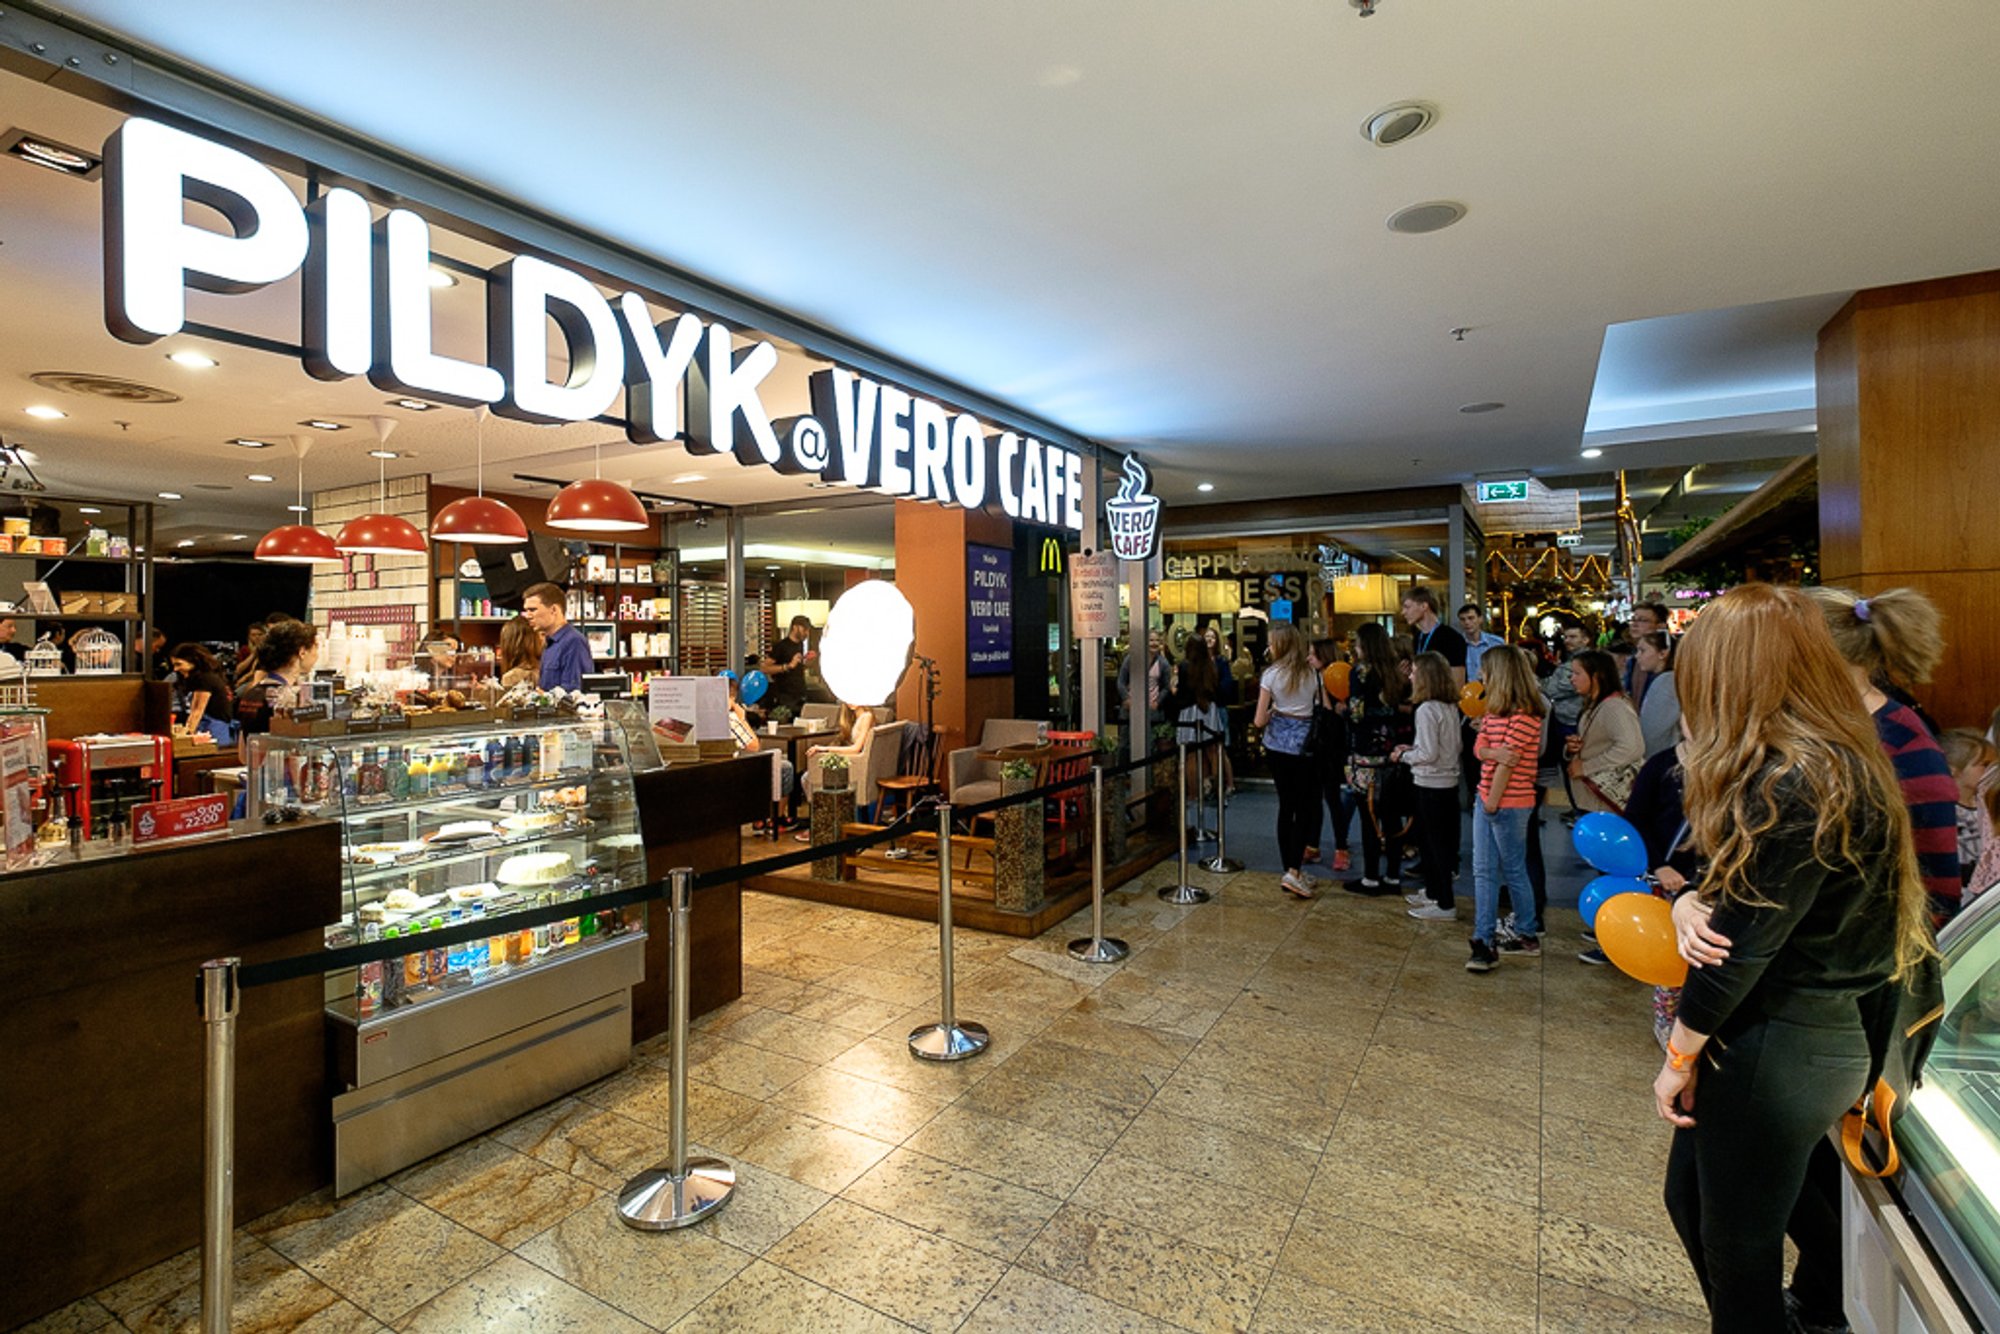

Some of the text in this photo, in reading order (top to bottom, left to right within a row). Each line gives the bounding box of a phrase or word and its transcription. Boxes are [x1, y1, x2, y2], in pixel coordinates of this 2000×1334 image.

[115, 115, 1084, 531] PILDYK @ VERO CAFE
[1107, 508, 1156, 533] VERO
[1113, 532, 1152, 556] CAFE
[973, 570, 1008, 588] PILDYK
[1167, 577, 1325, 607] ESPRESSO
[970, 600, 1010, 617] VERO CAFE
